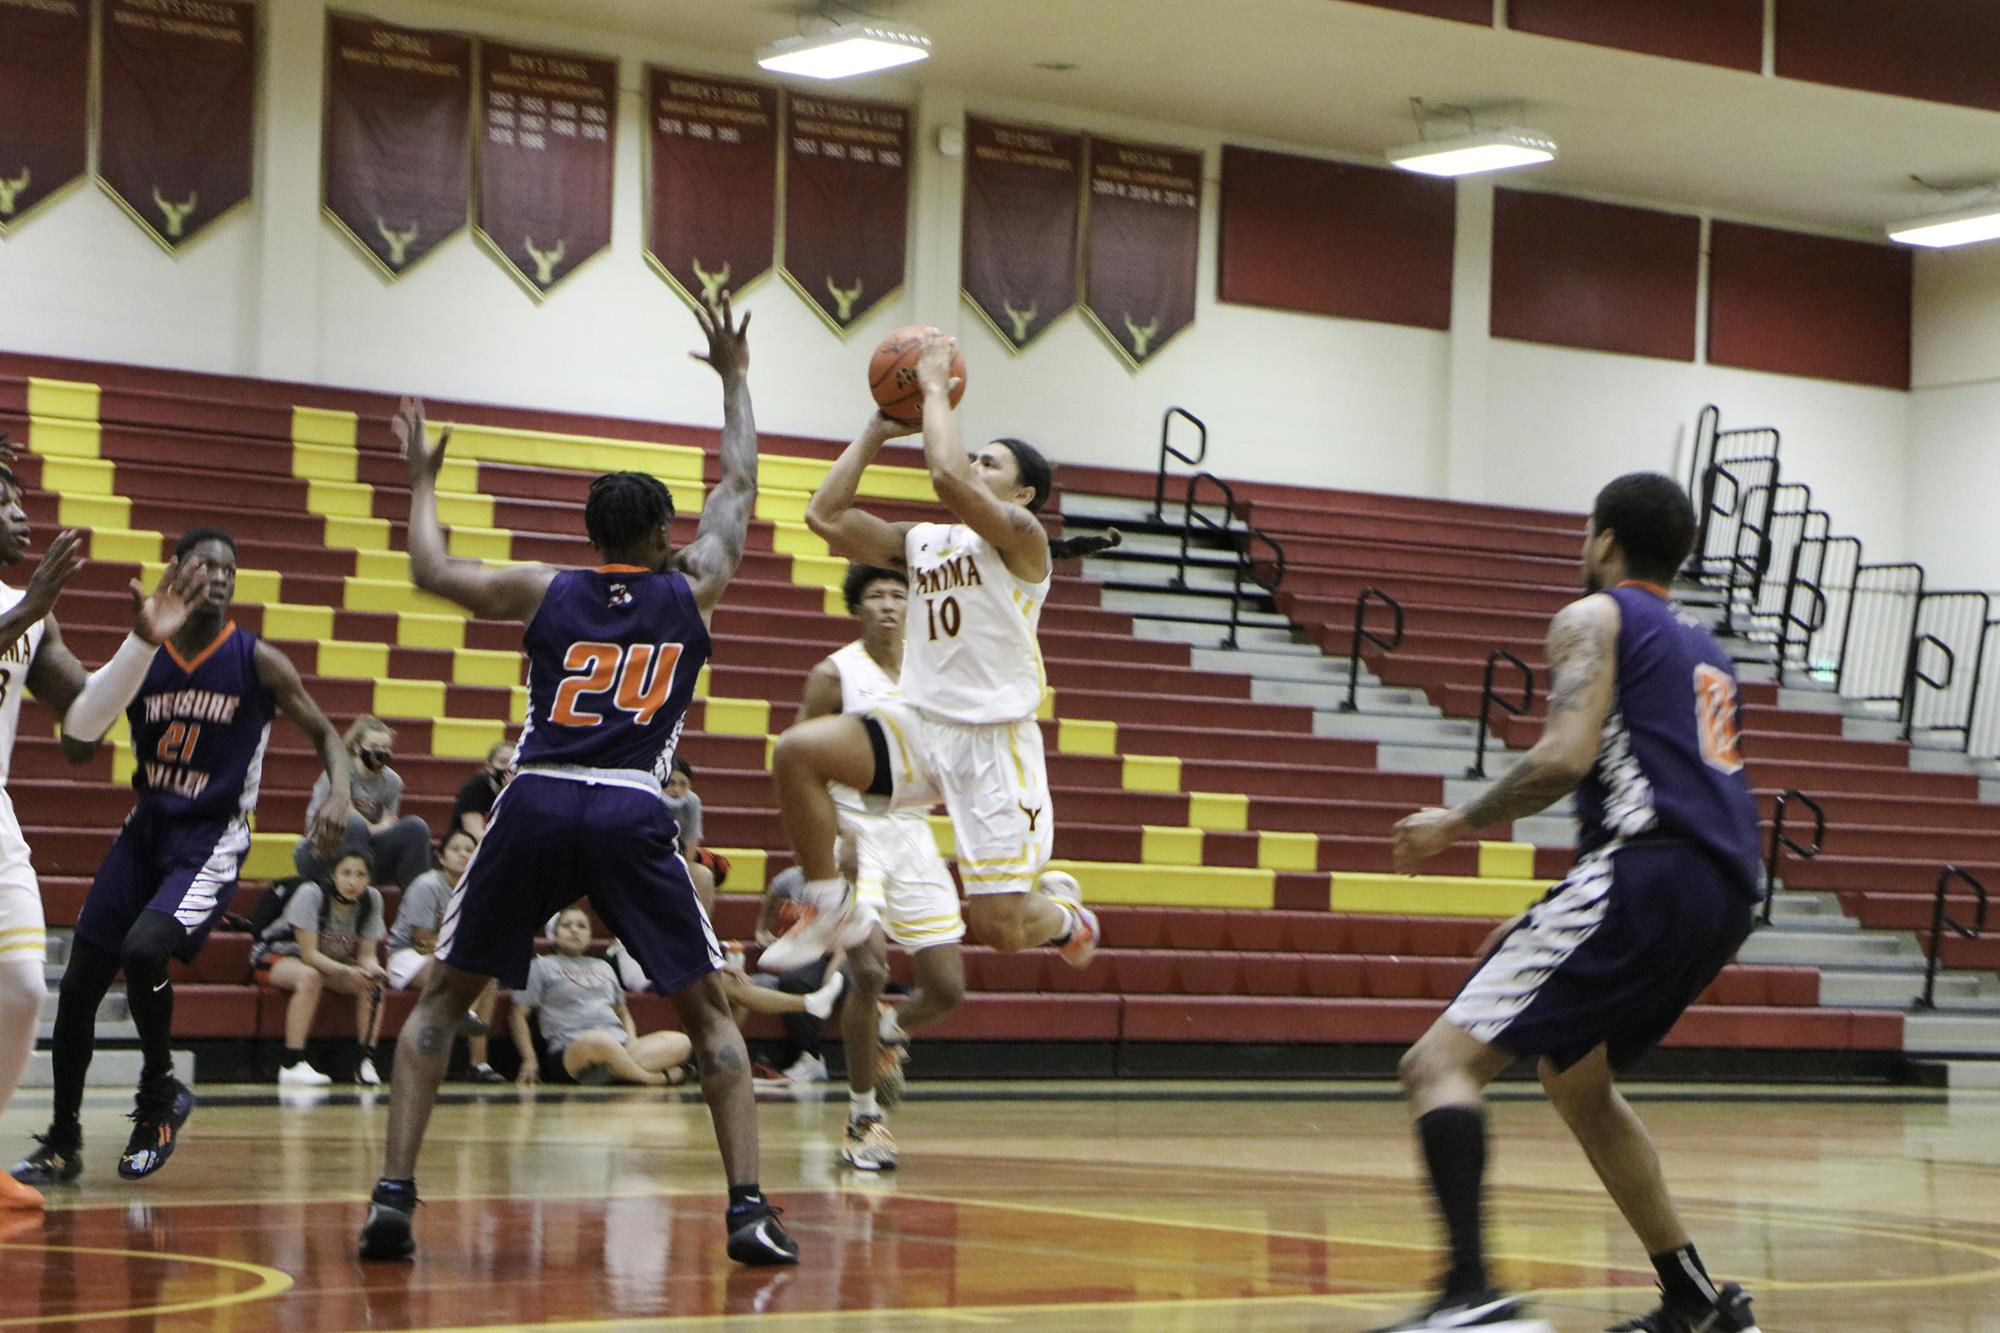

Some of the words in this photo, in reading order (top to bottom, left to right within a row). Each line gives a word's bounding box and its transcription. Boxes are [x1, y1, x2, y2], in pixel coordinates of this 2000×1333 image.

[926, 595, 961, 641] 10
[548, 641, 684, 727] 24
[157, 719, 201, 765] 21
